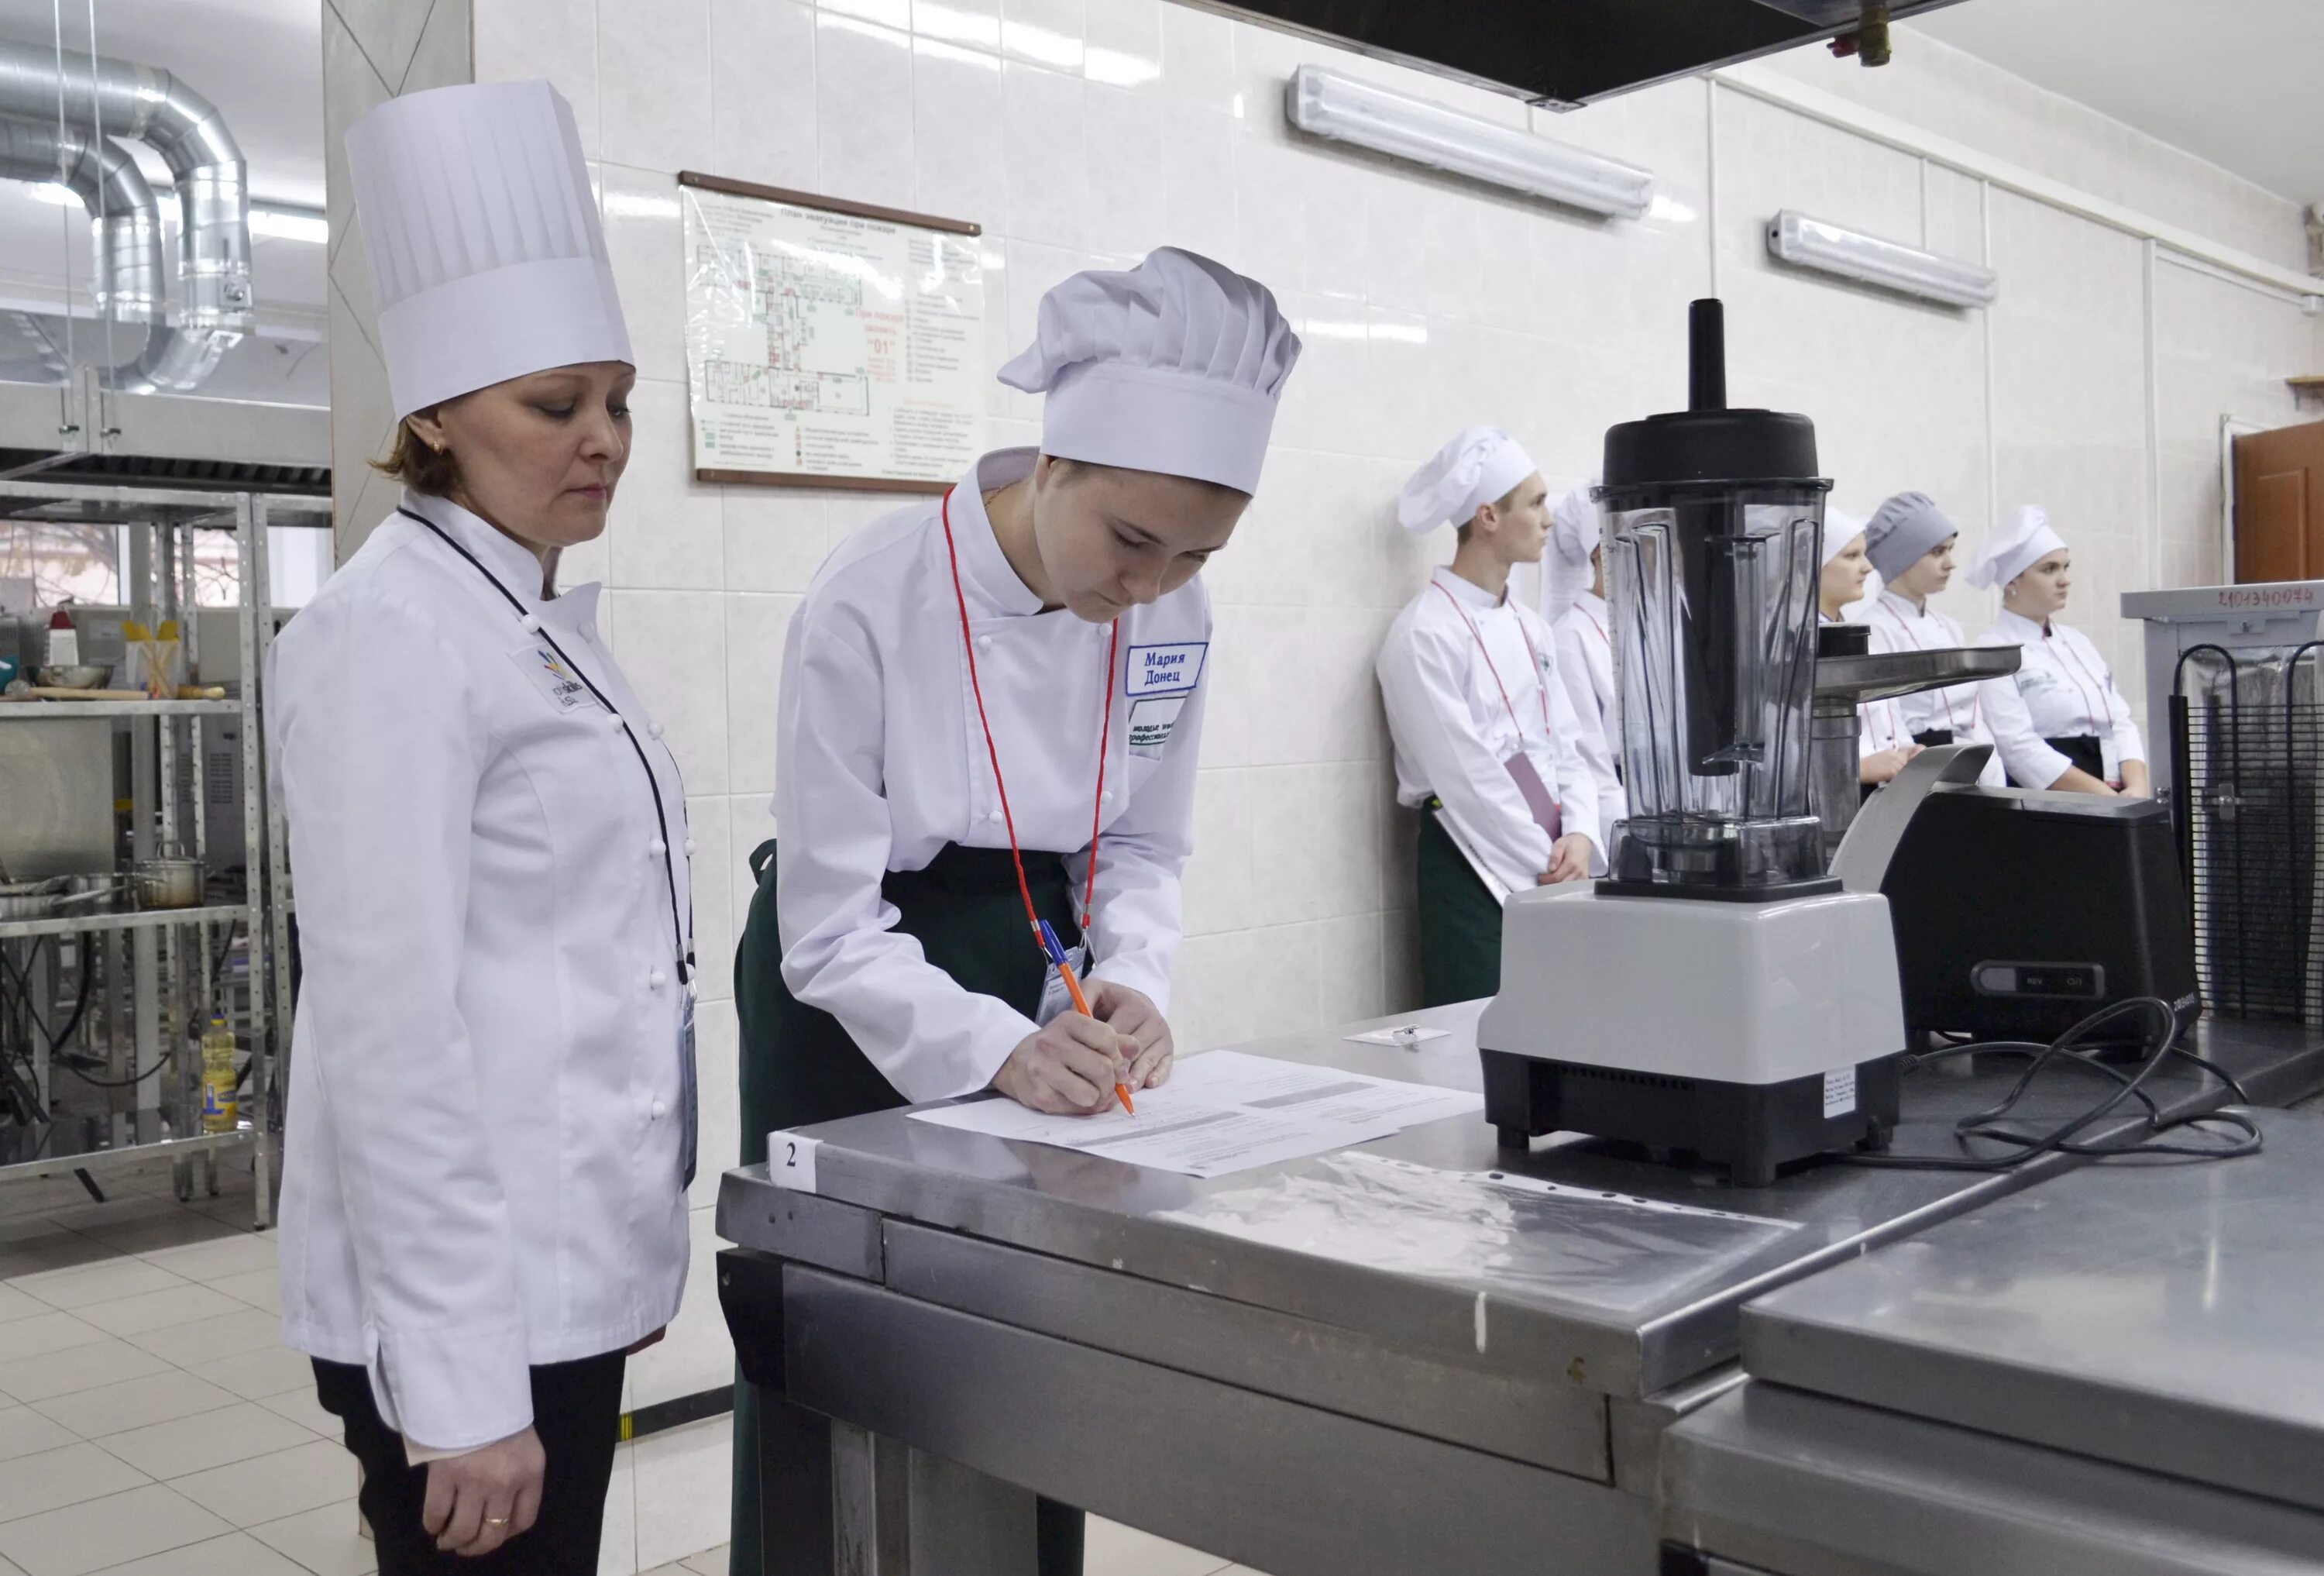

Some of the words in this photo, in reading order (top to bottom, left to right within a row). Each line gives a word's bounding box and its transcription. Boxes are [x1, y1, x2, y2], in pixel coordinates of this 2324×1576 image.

[1144, 652, 1185, 668] Мария
[1144, 670, 1180, 686] Донец
[786, 1142, 796, 1166] 2
